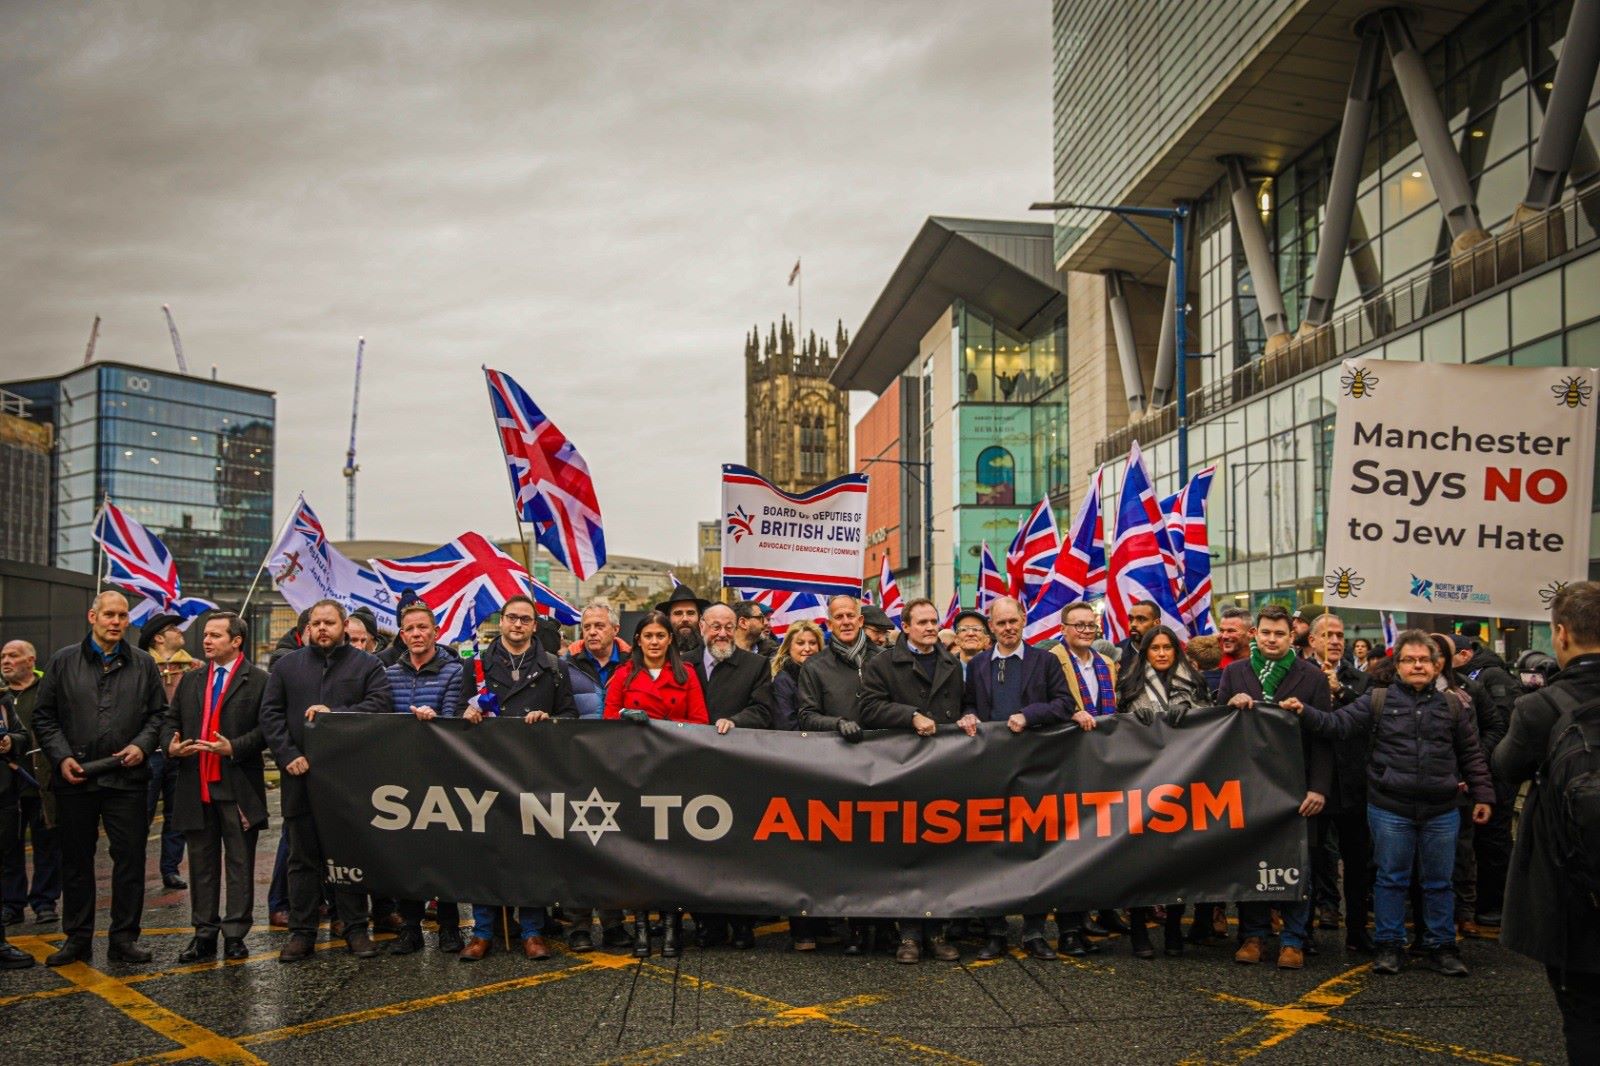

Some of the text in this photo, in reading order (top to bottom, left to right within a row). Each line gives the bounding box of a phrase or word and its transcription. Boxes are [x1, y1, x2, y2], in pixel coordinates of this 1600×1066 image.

[1353, 421, 1571, 456] Manchester
[1350, 459, 1568, 506] Says NO
[763, 506, 797, 518] BOARD
[812, 511, 852, 522] DEPUTIES
[854, 513, 862, 522] OF
[761, 520, 824, 540] BRITISH
[827, 526, 861, 542] JEWS
[1348, 517, 1564, 552] to Jew Hate
[759, 542, 791, 550] ADVOCACY
[795, 545, 831, 554] DEMOCRACY
[1434, 583, 1473, 592] NORTH WEST
[1434, 591, 1459, 600] FRIENDS
[370, 784, 500, 833] SAY
[640, 794, 733, 841] TO
[753, 780, 1245, 844] ANTISEMITISM
[326, 859, 364, 883] jrc
[1256, 861, 1300, 891] jrc
